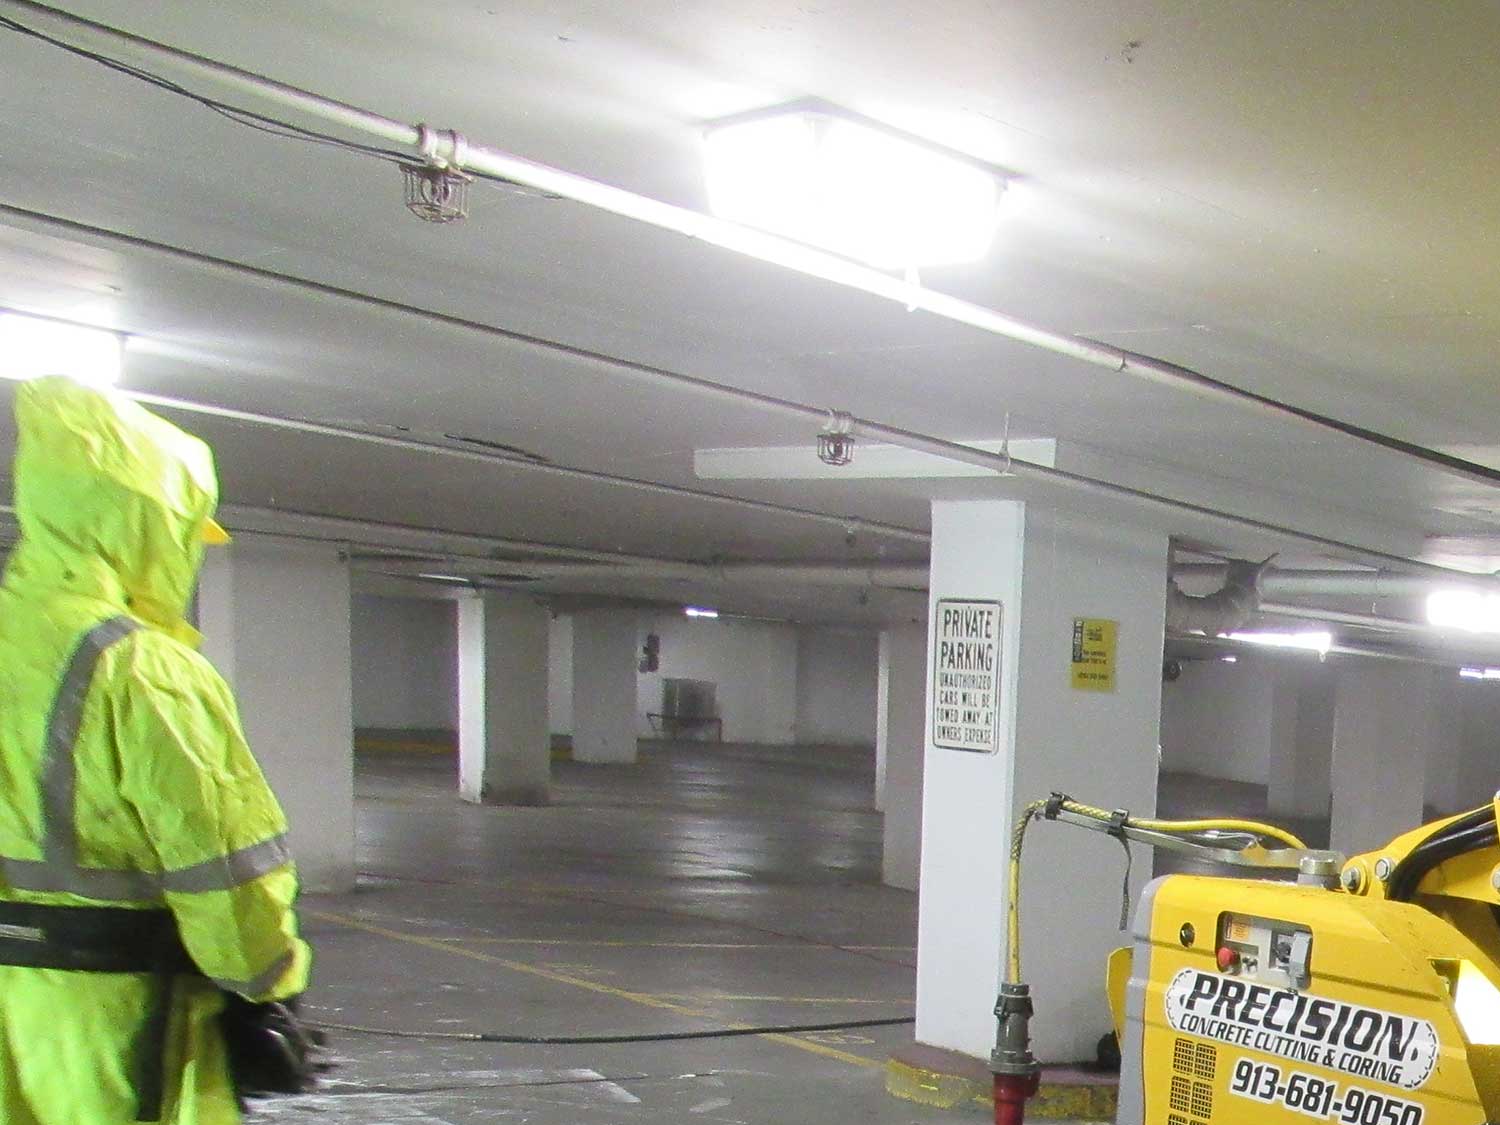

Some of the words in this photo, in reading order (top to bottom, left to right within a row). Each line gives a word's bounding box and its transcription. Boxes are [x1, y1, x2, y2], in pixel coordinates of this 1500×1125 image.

[943, 608, 993, 639] PRIVATE
[940, 641, 993, 671] PARKING
[939, 672, 991, 690] UNAUTHORIZED
[939, 690, 958, 705] CARS
[961, 692, 977, 707] WILL
[981, 694, 991, 708] BE
[936, 707, 959, 723] TOWED
[962, 710, 980, 725] AWAY
[985, 711, 993, 727] AT
[963, 727, 991, 744] EXPENSE
[1184, 972, 1419, 1062] PRECISION
[1179, 1012, 1254, 1046] CONCRETE
[1253, 1031, 1322, 1064] CUTTING
[1322, 1048, 1338, 1068] &
[1337, 1052, 1404, 1085] CORING
